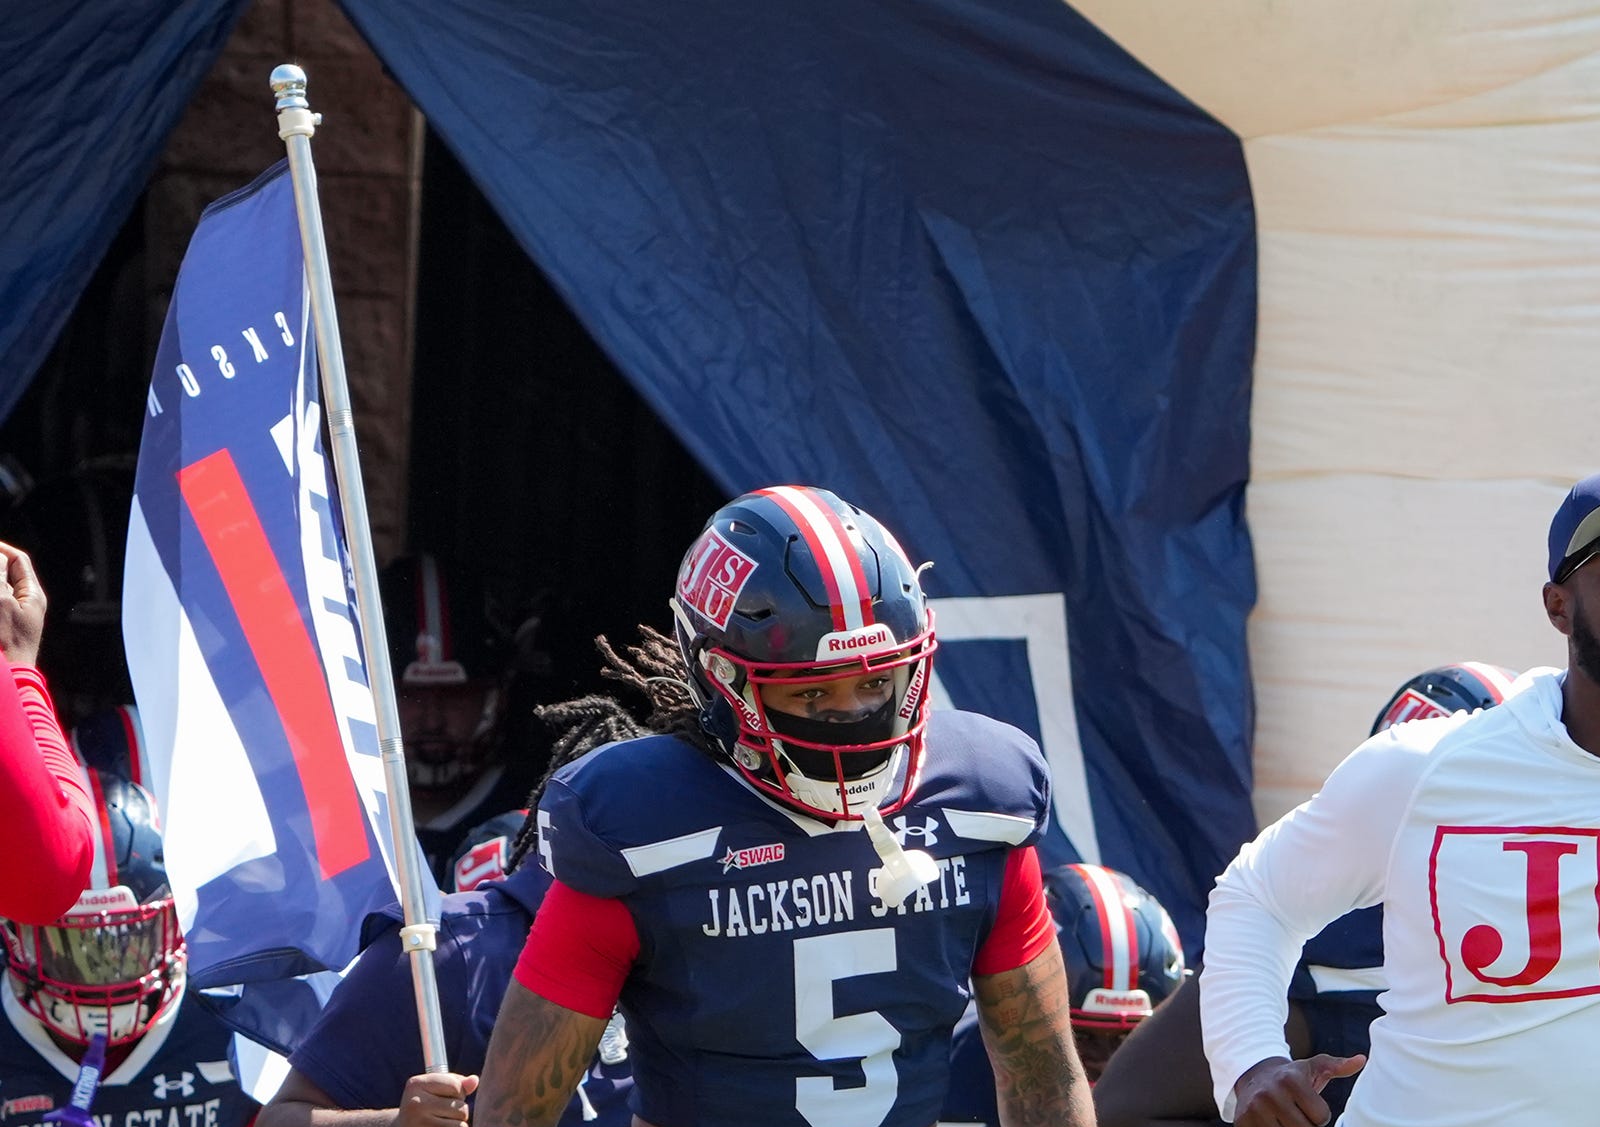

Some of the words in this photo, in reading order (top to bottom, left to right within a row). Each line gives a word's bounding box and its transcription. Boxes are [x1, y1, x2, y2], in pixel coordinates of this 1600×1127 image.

[828, 630, 887, 652] Riddell
[739, 844, 785, 868] SWAC
[702, 870, 854, 938] JACKSON
